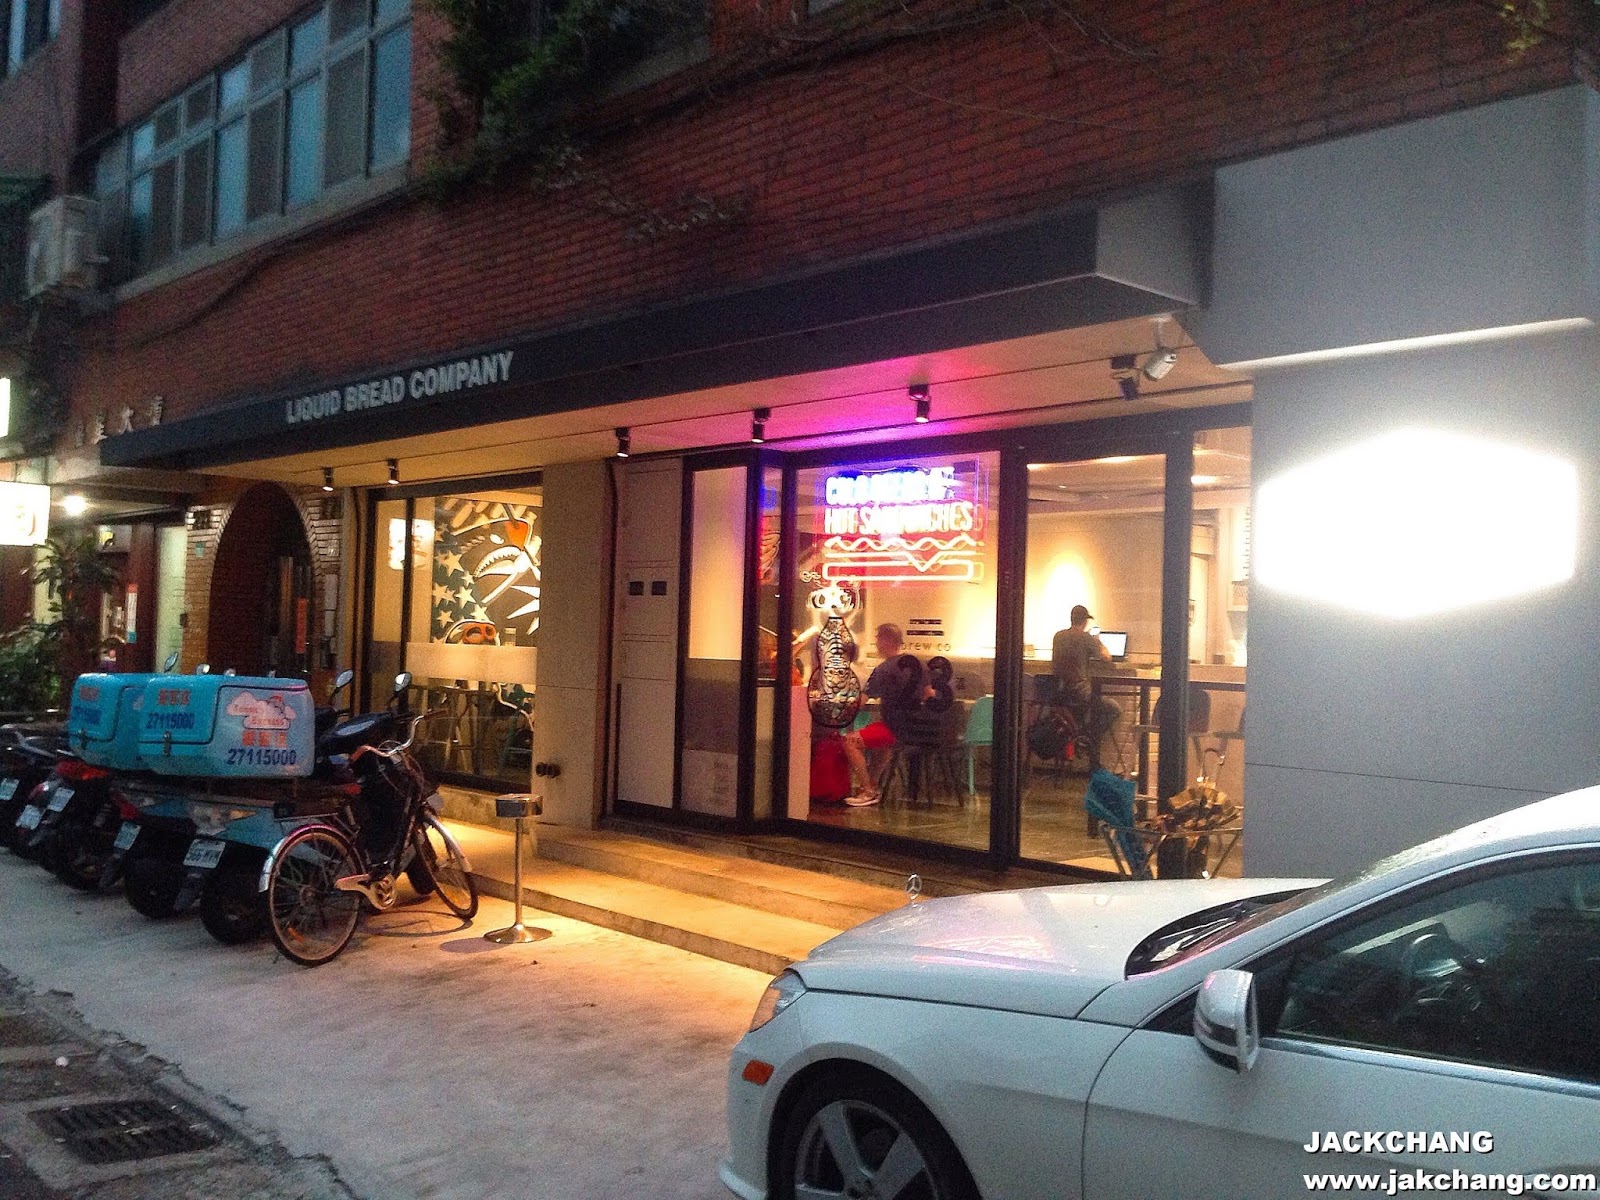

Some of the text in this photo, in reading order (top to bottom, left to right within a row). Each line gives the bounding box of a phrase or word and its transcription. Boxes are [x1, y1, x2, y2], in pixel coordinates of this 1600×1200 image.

[285, 350, 514, 424] LIQUID BREAD COMPANY
[226, 748, 297, 767] 27115000
